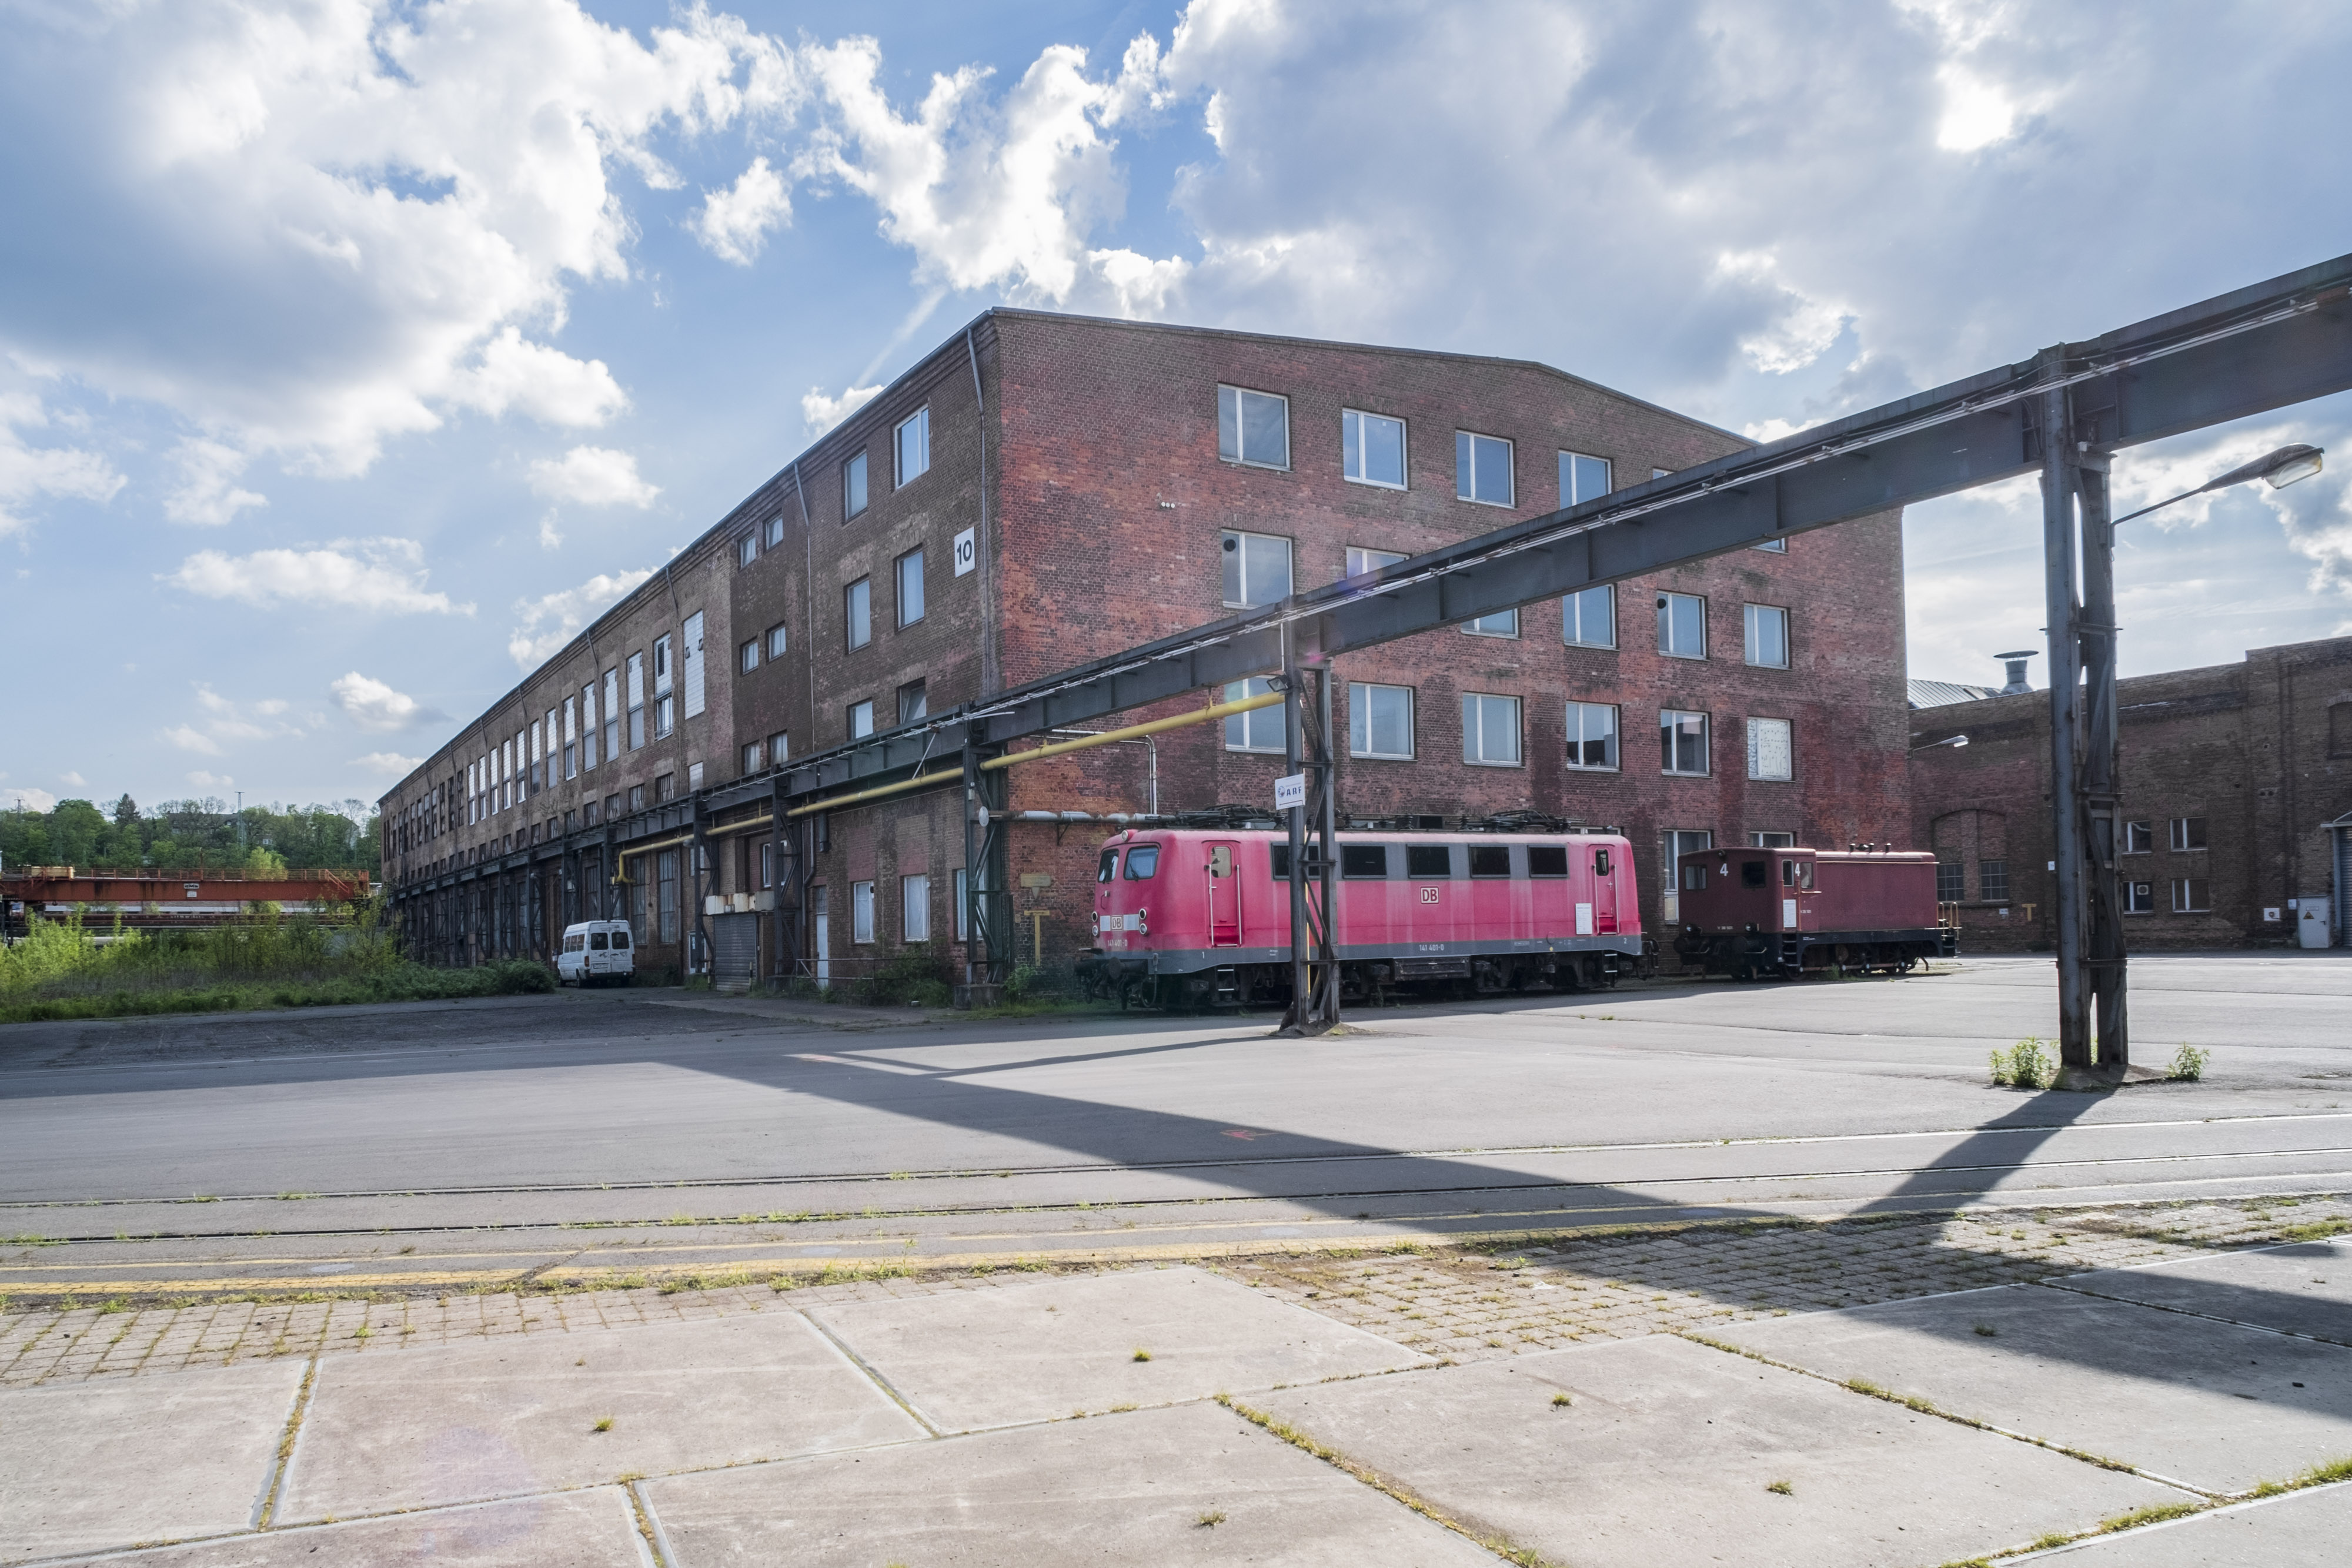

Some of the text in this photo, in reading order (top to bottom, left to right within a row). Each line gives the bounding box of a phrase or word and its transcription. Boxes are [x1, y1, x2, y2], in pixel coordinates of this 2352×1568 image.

[957, 540, 972, 565] 10
[1286, 786, 1301, 796] ARF
[1720, 863, 1728, 877] 4
[1795, 863, 1800, 877] 4
[1422, 888, 1438, 902] DB
[1112, 917, 1122, 928] DB
